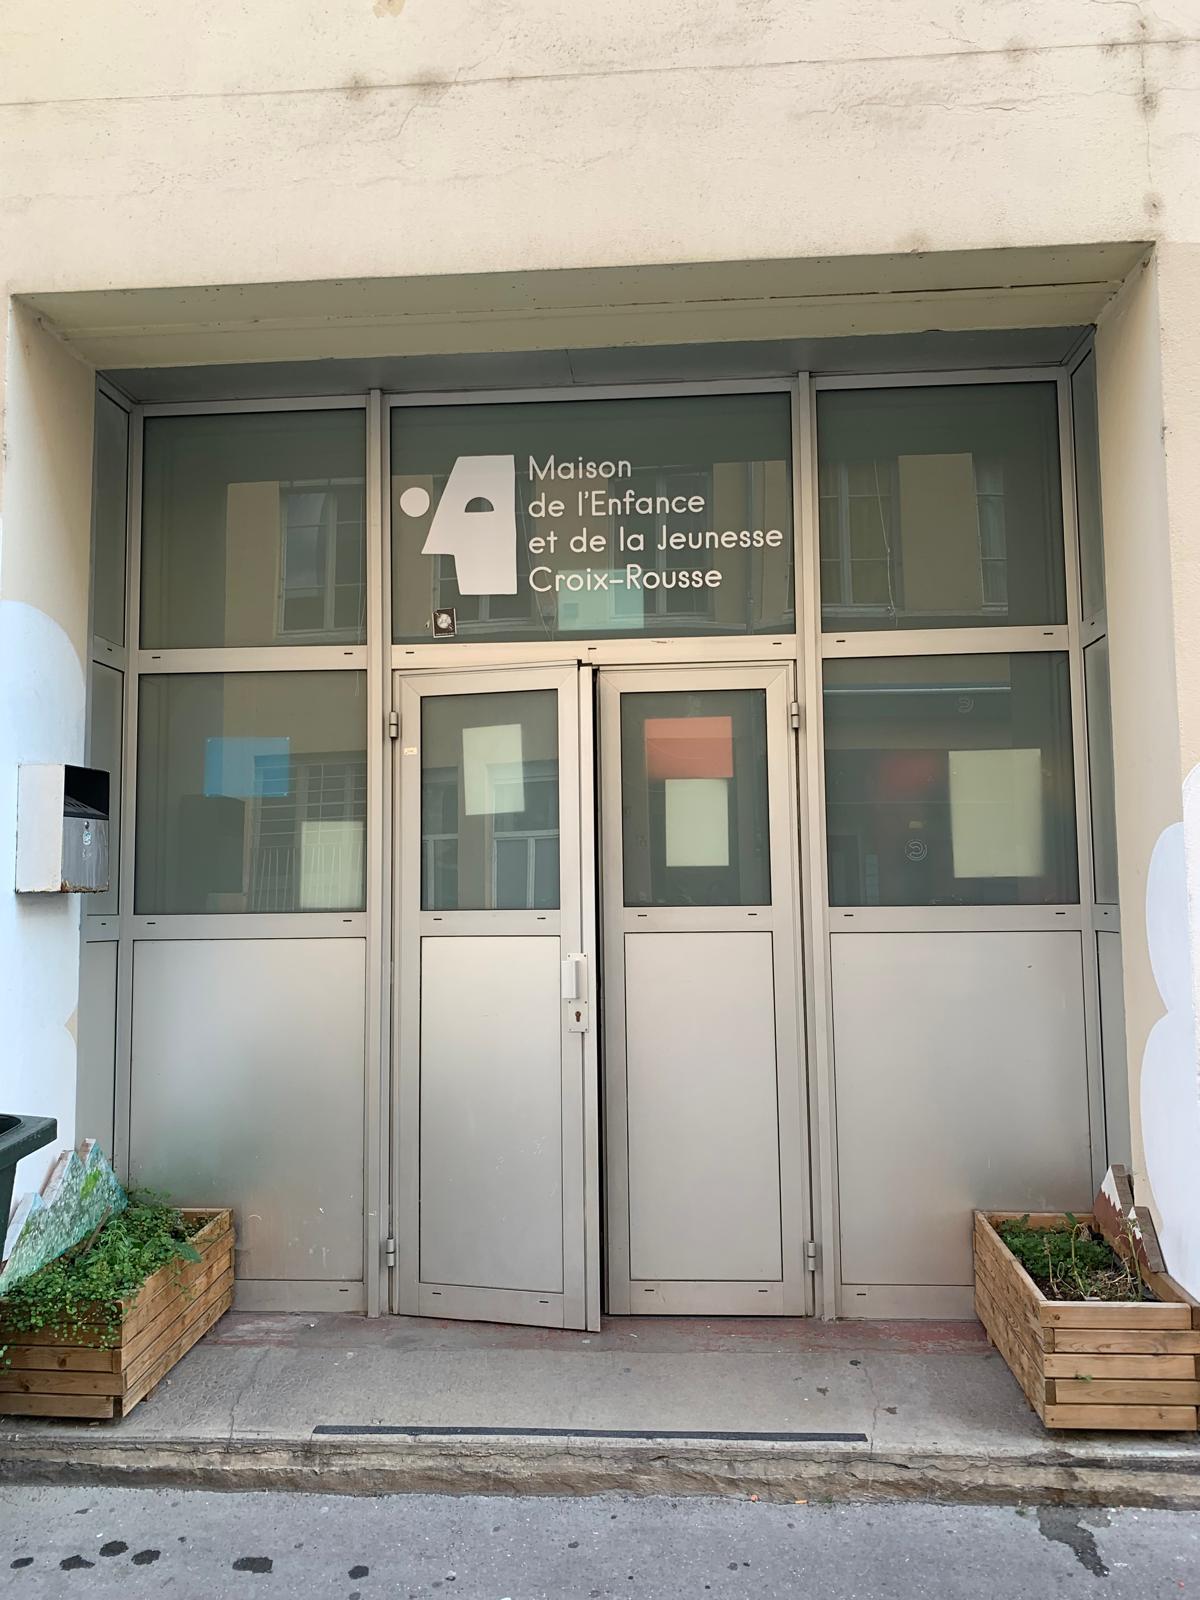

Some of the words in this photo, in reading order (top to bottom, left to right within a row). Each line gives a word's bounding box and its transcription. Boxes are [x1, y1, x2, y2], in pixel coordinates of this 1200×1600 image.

[529, 455, 632, 481] Maison
[528, 492, 565, 518] de
[578, 490, 705, 516] l'Enfance
[528, 530, 558, 554] et
[569, 527, 607, 553] de
[619, 526, 644, 552] la
[657, 525, 783, 551] Jeunesse
[528, 563, 723, 592] Croix-Rousse
